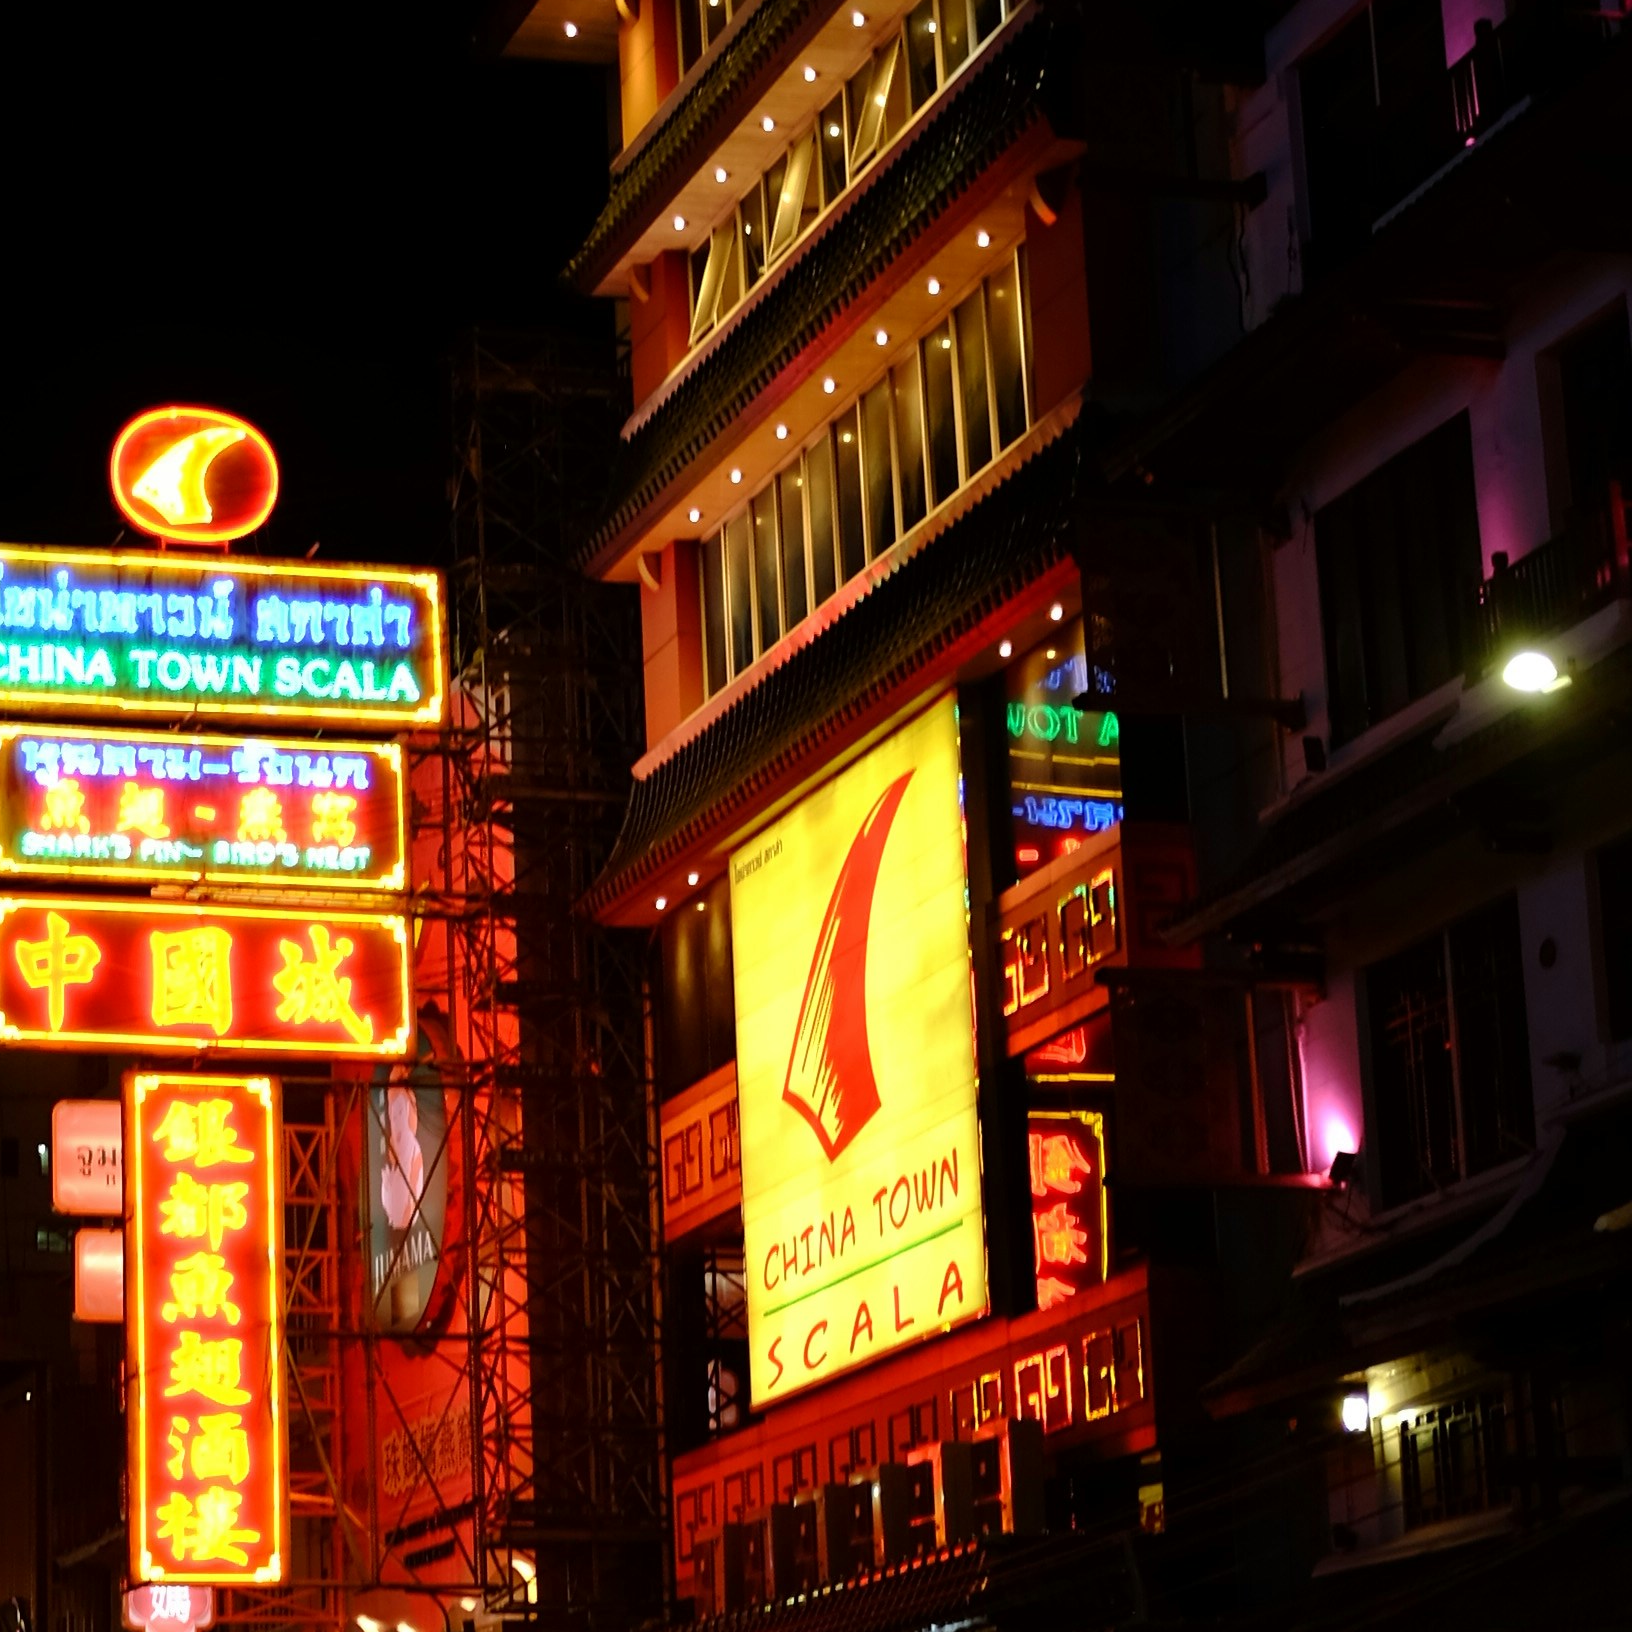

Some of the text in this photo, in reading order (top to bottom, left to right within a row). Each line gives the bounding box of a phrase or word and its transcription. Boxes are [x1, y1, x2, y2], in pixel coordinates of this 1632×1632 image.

[129, 651, 264, 696] TOWN
[275, 657, 420, 703] SCALA
[21, 831, 132, 860] SHARK'S
[213, 840, 299, 867] BIRD'S
[304, 846, 370, 871] NEST
[14, 911, 373, 1046] 中國城
[763, 1204, 856, 1291] CHINA
[872, 1148, 959, 1235] TOWN
[768, 1261, 965, 1389] SCALA
